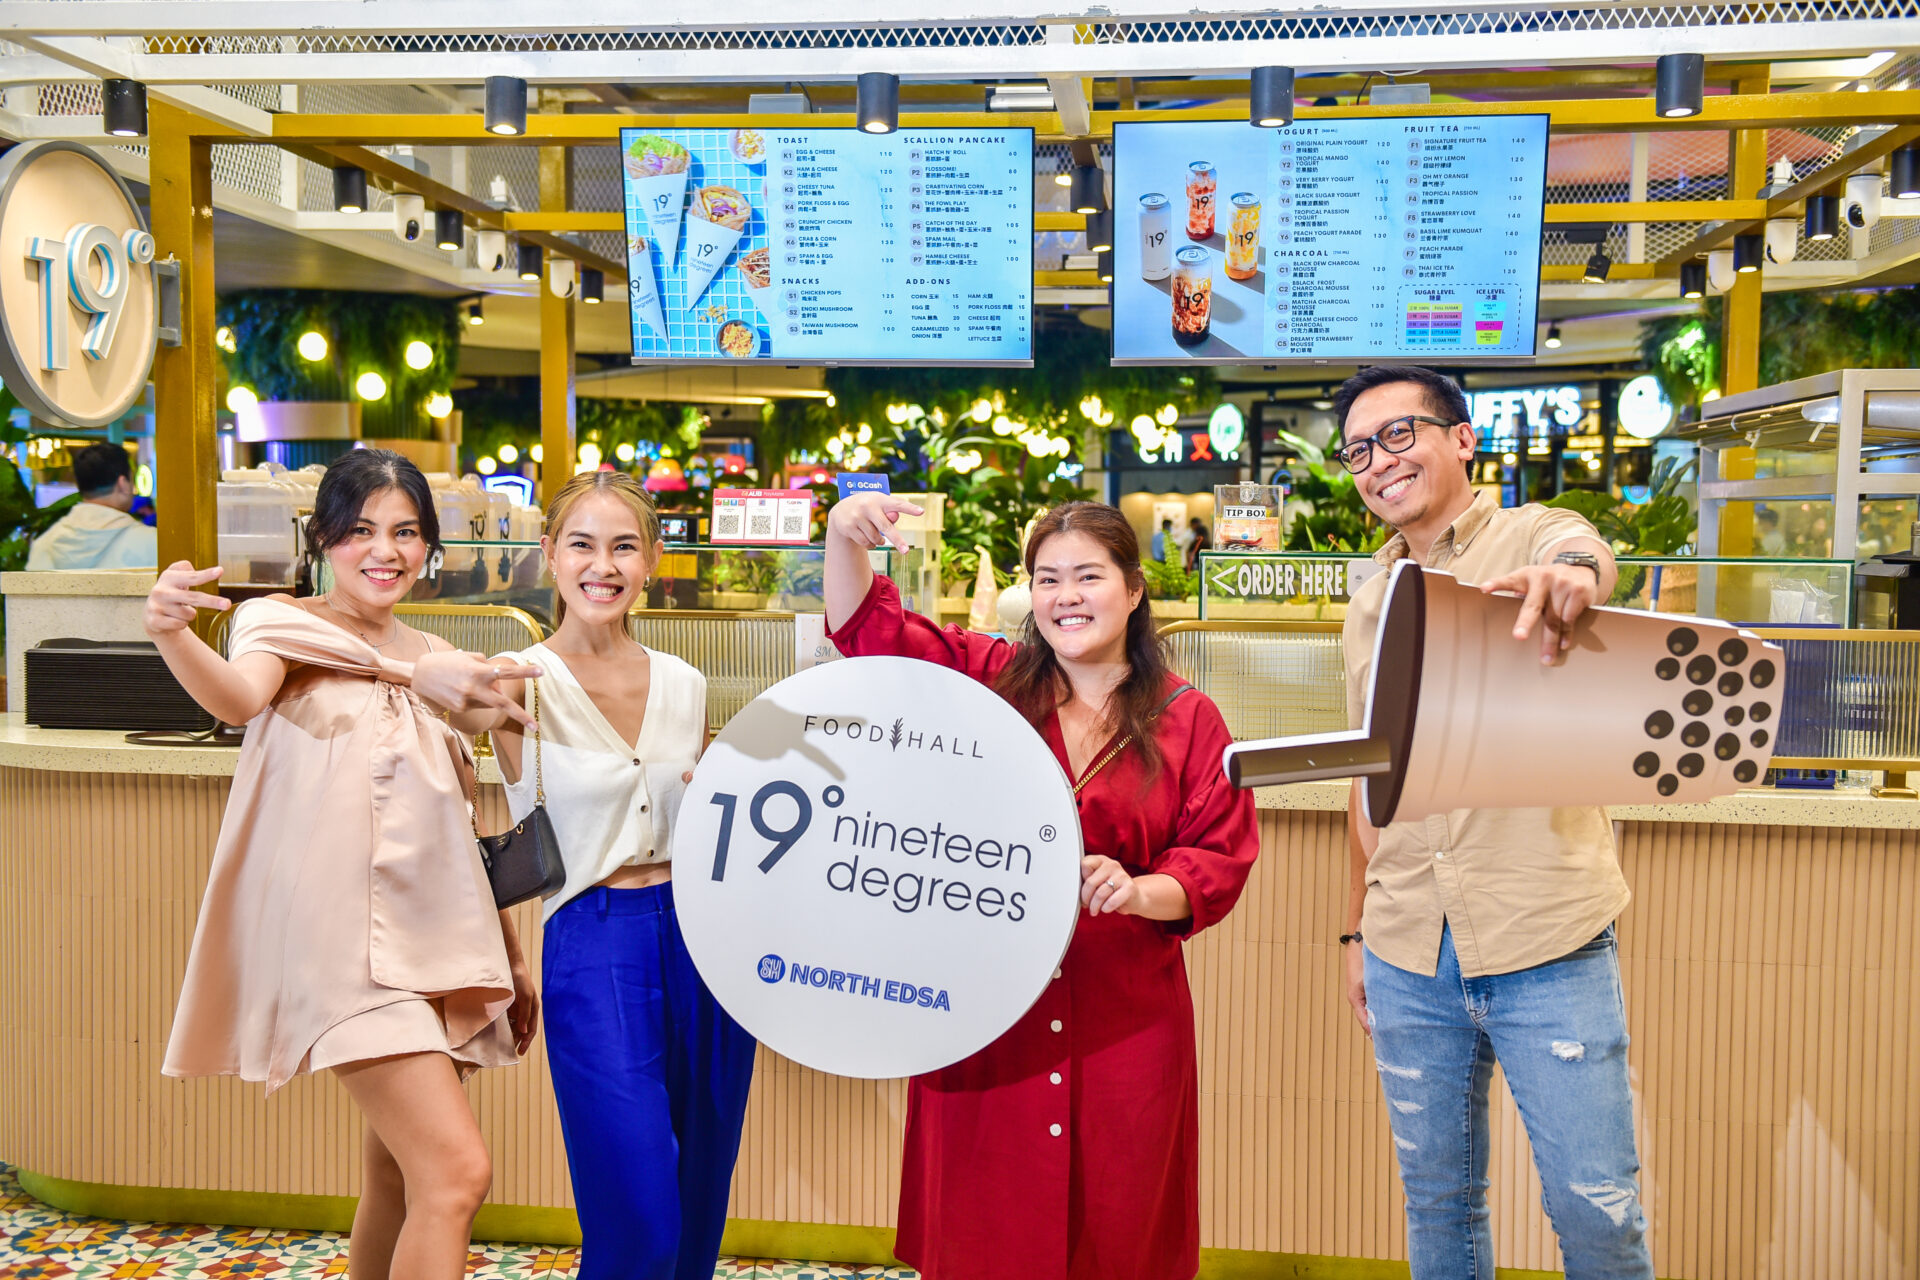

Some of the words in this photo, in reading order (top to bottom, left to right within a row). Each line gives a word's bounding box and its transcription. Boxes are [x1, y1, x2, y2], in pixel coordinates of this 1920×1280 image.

[1226, 509, 1243, 517] TIP
[1246, 509, 1266, 517] BOX
[1238, 564, 1295, 597] ORDER
[1301, 564, 1343, 596] HERE
[804, 714, 884, 744] FOOD
[908, 730, 984, 758] HALL
[710, 780, 844, 882] 19°
[833, 811, 1032, 874] nineteen
[826, 855, 1026, 922] degrees
[790, 963, 880, 998] NORTH
[884, 980, 951, 1012] EDSA
